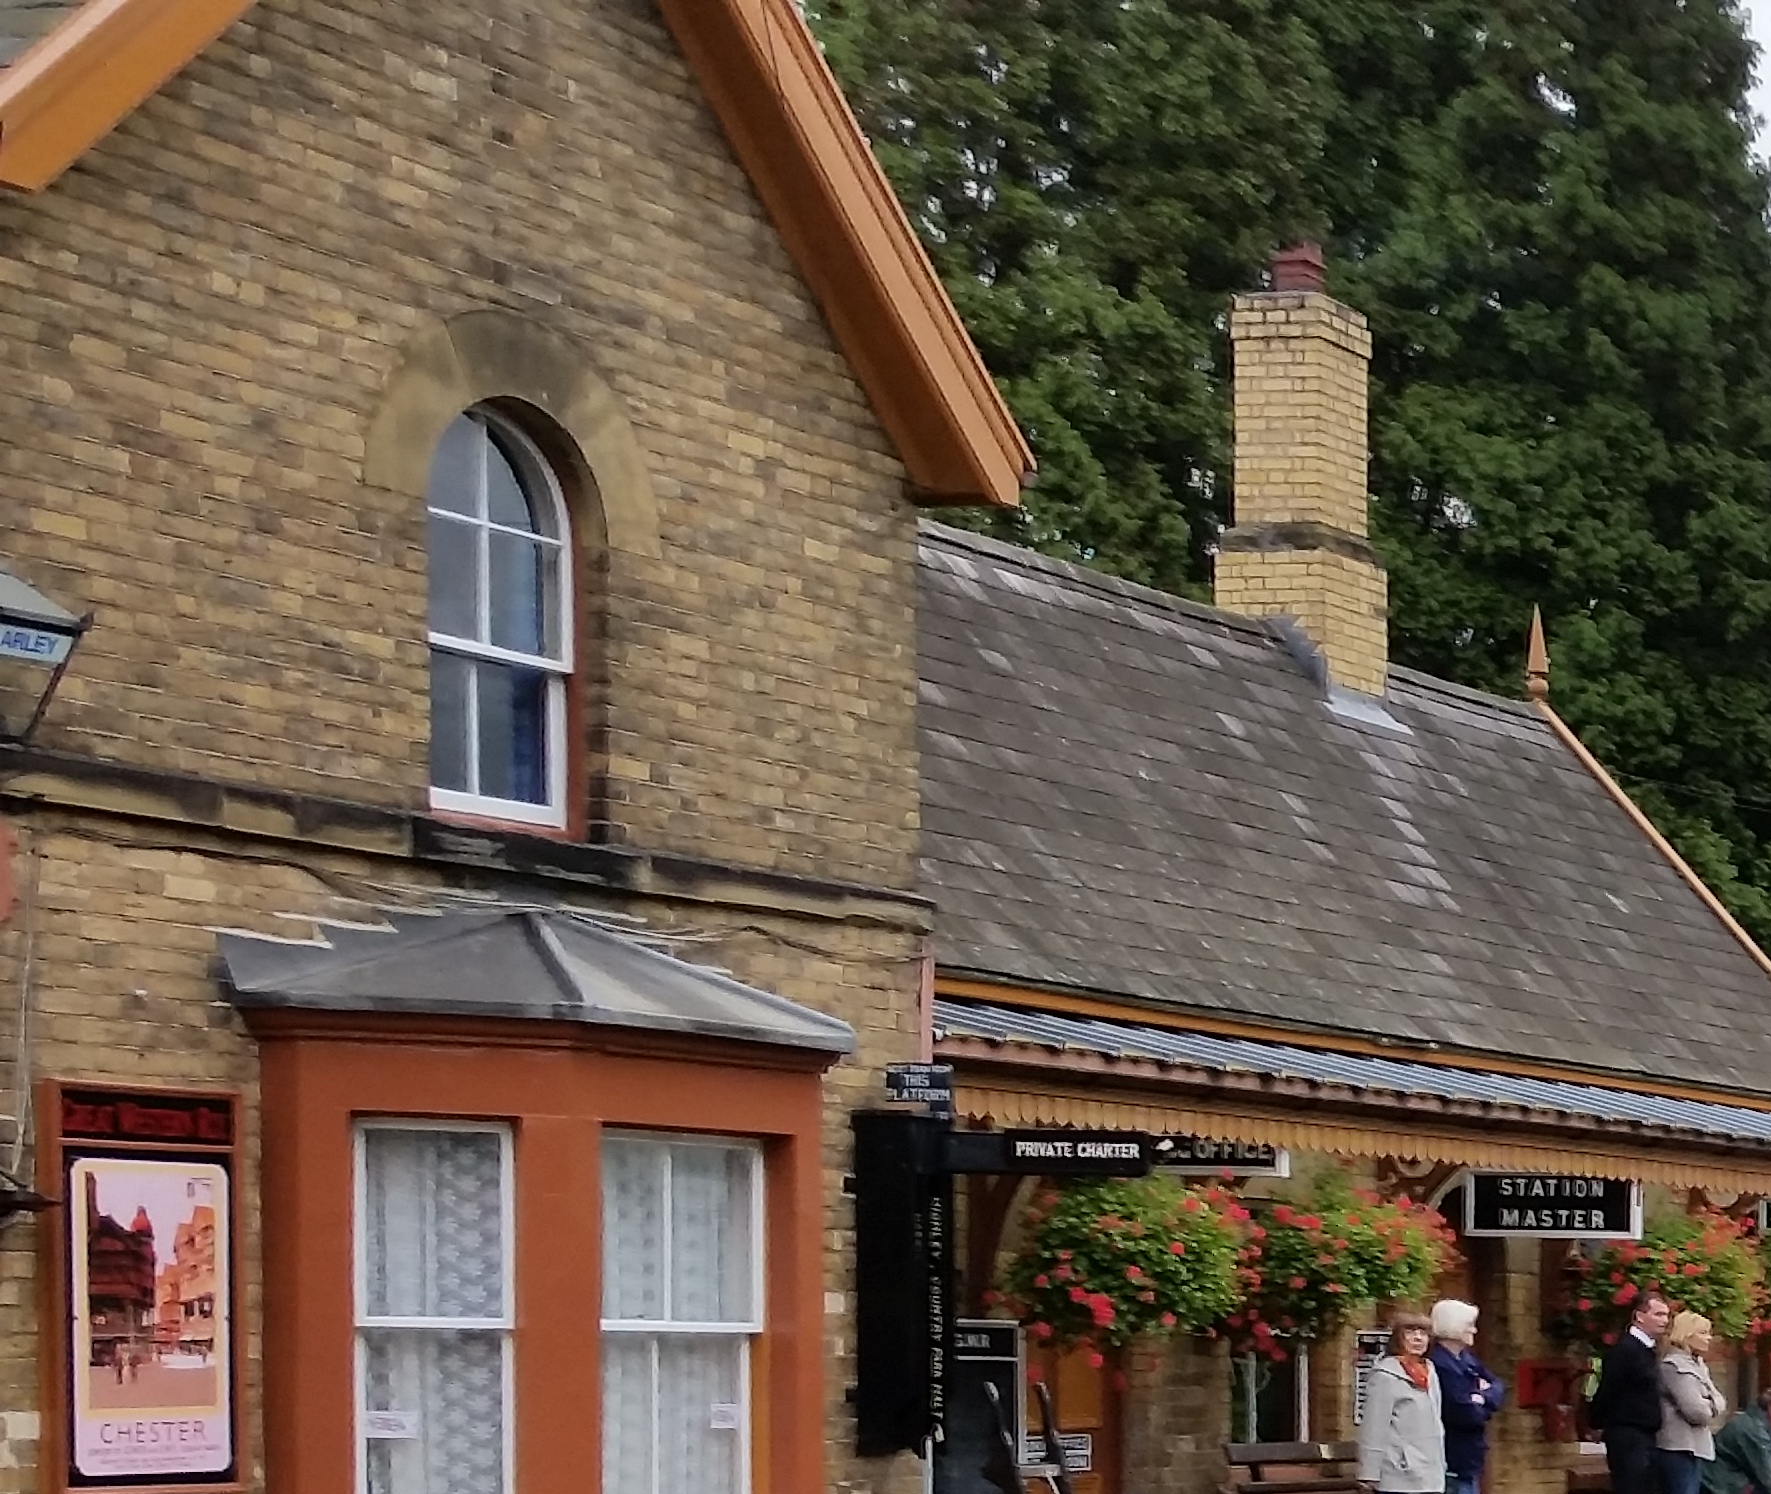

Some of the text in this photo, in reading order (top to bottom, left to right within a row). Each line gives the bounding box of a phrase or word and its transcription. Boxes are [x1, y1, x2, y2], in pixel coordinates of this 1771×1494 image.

[1, 630, 60, 655] ARLEY
[1015, 1140, 1140, 1159] PRIVATE CHARTER
[1499, 1178, 1605, 1198] STATION
[1499, 1208, 1606, 1229] MASTER
[100, 1420, 207, 1444] CHESTER
